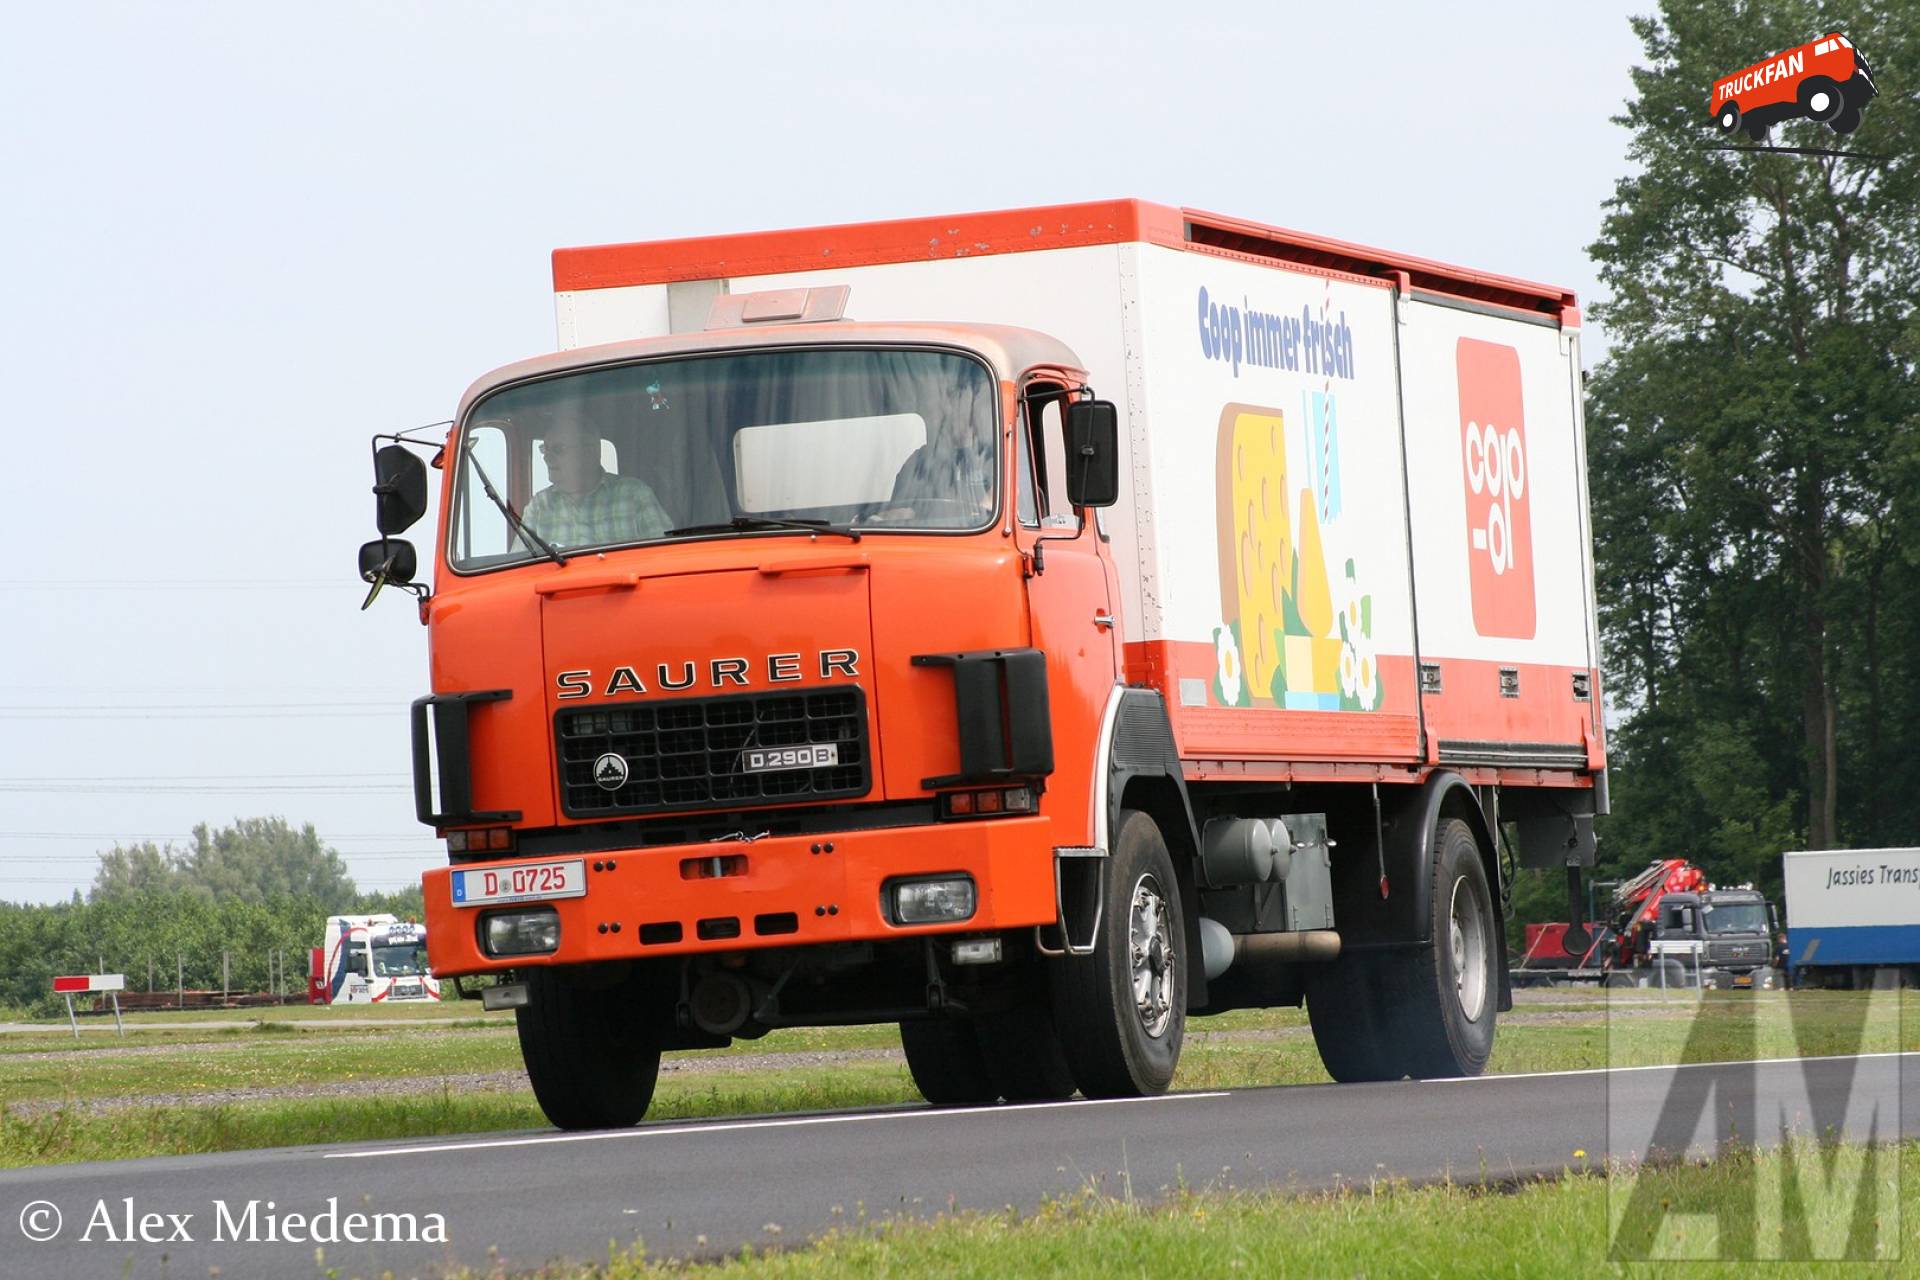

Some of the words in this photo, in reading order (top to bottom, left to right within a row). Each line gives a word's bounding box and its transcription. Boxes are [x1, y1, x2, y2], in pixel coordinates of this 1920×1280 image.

[1198, 285, 1243, 378] Coop
[1243, 294, 1300, 372] immer
[1303, 303, 1355, 380] frisch
[556, 648, 859, 699] SAURER
[512, 866, 566, 893] 0725
[1826, 864, 1875, 890] Jassies
[1879, 864, 1920, 890] Trans
